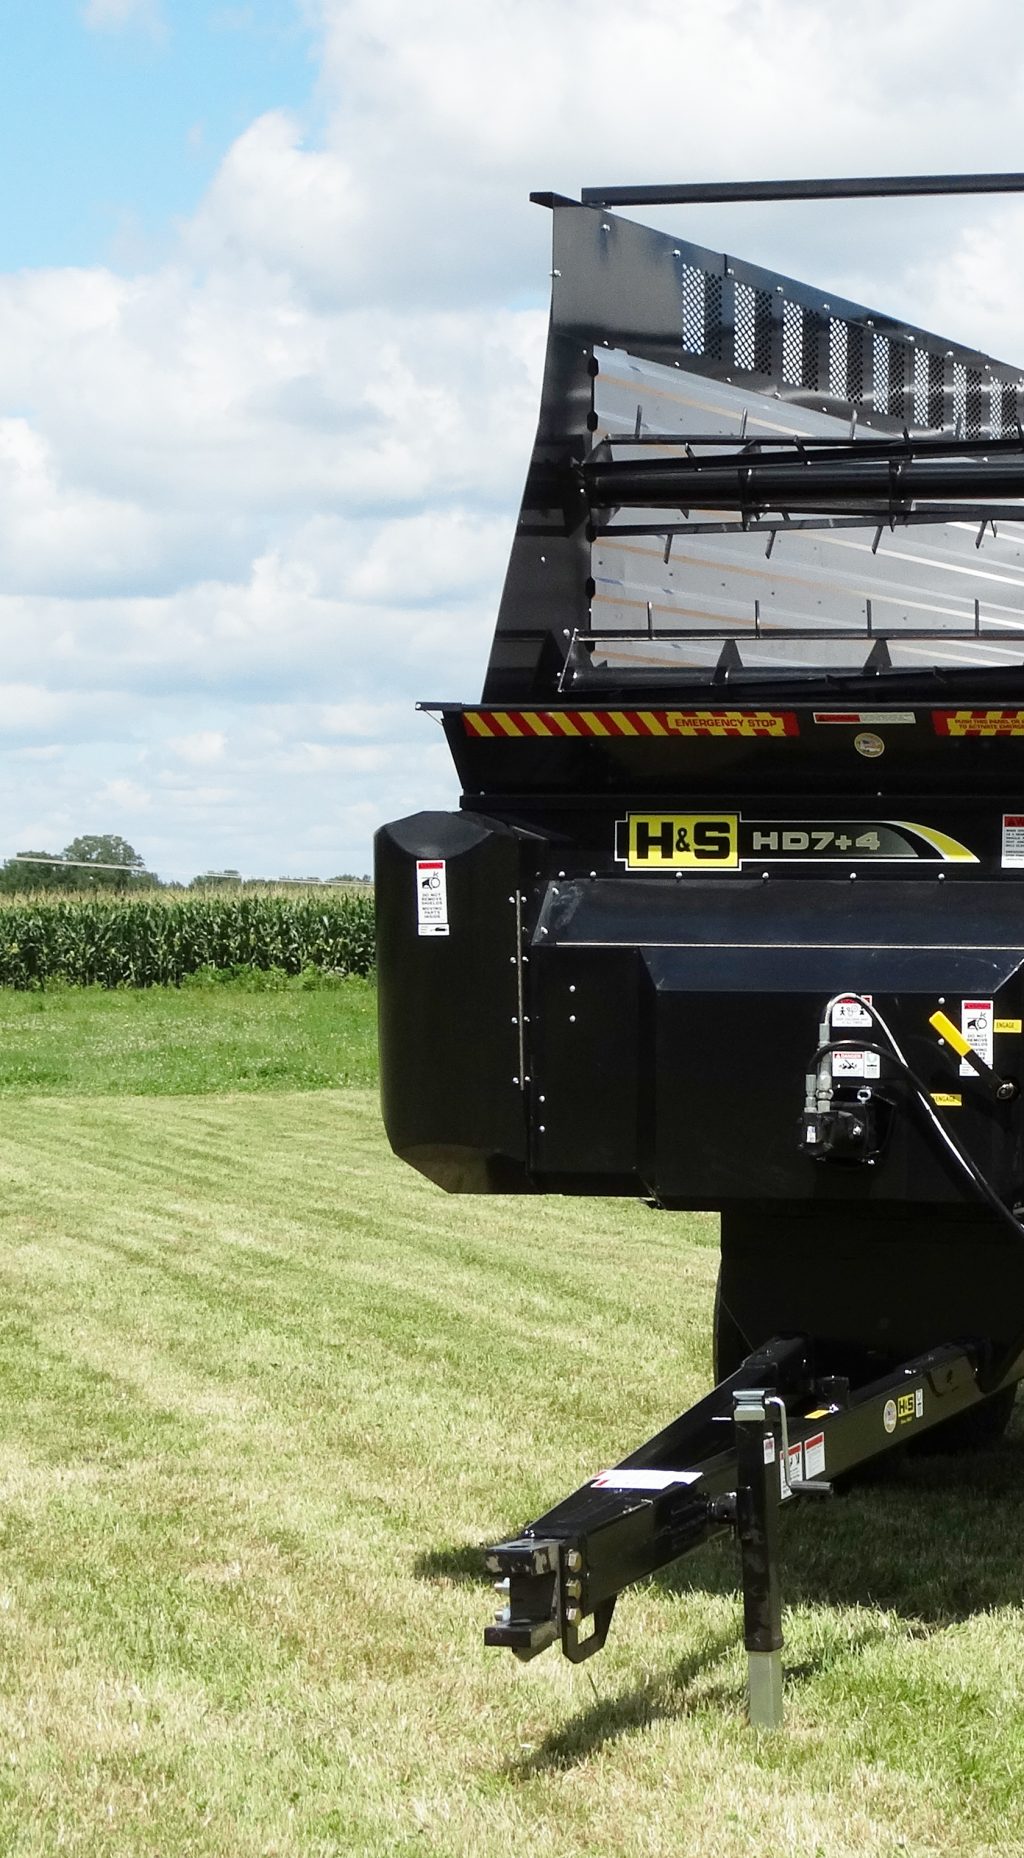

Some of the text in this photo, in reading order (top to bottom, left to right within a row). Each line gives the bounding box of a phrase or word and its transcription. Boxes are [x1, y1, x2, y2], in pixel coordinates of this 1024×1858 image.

[675, 718, 777, 728] EMERGENCY STOP
[636, 821, 880, 860] H&S HD7+4
